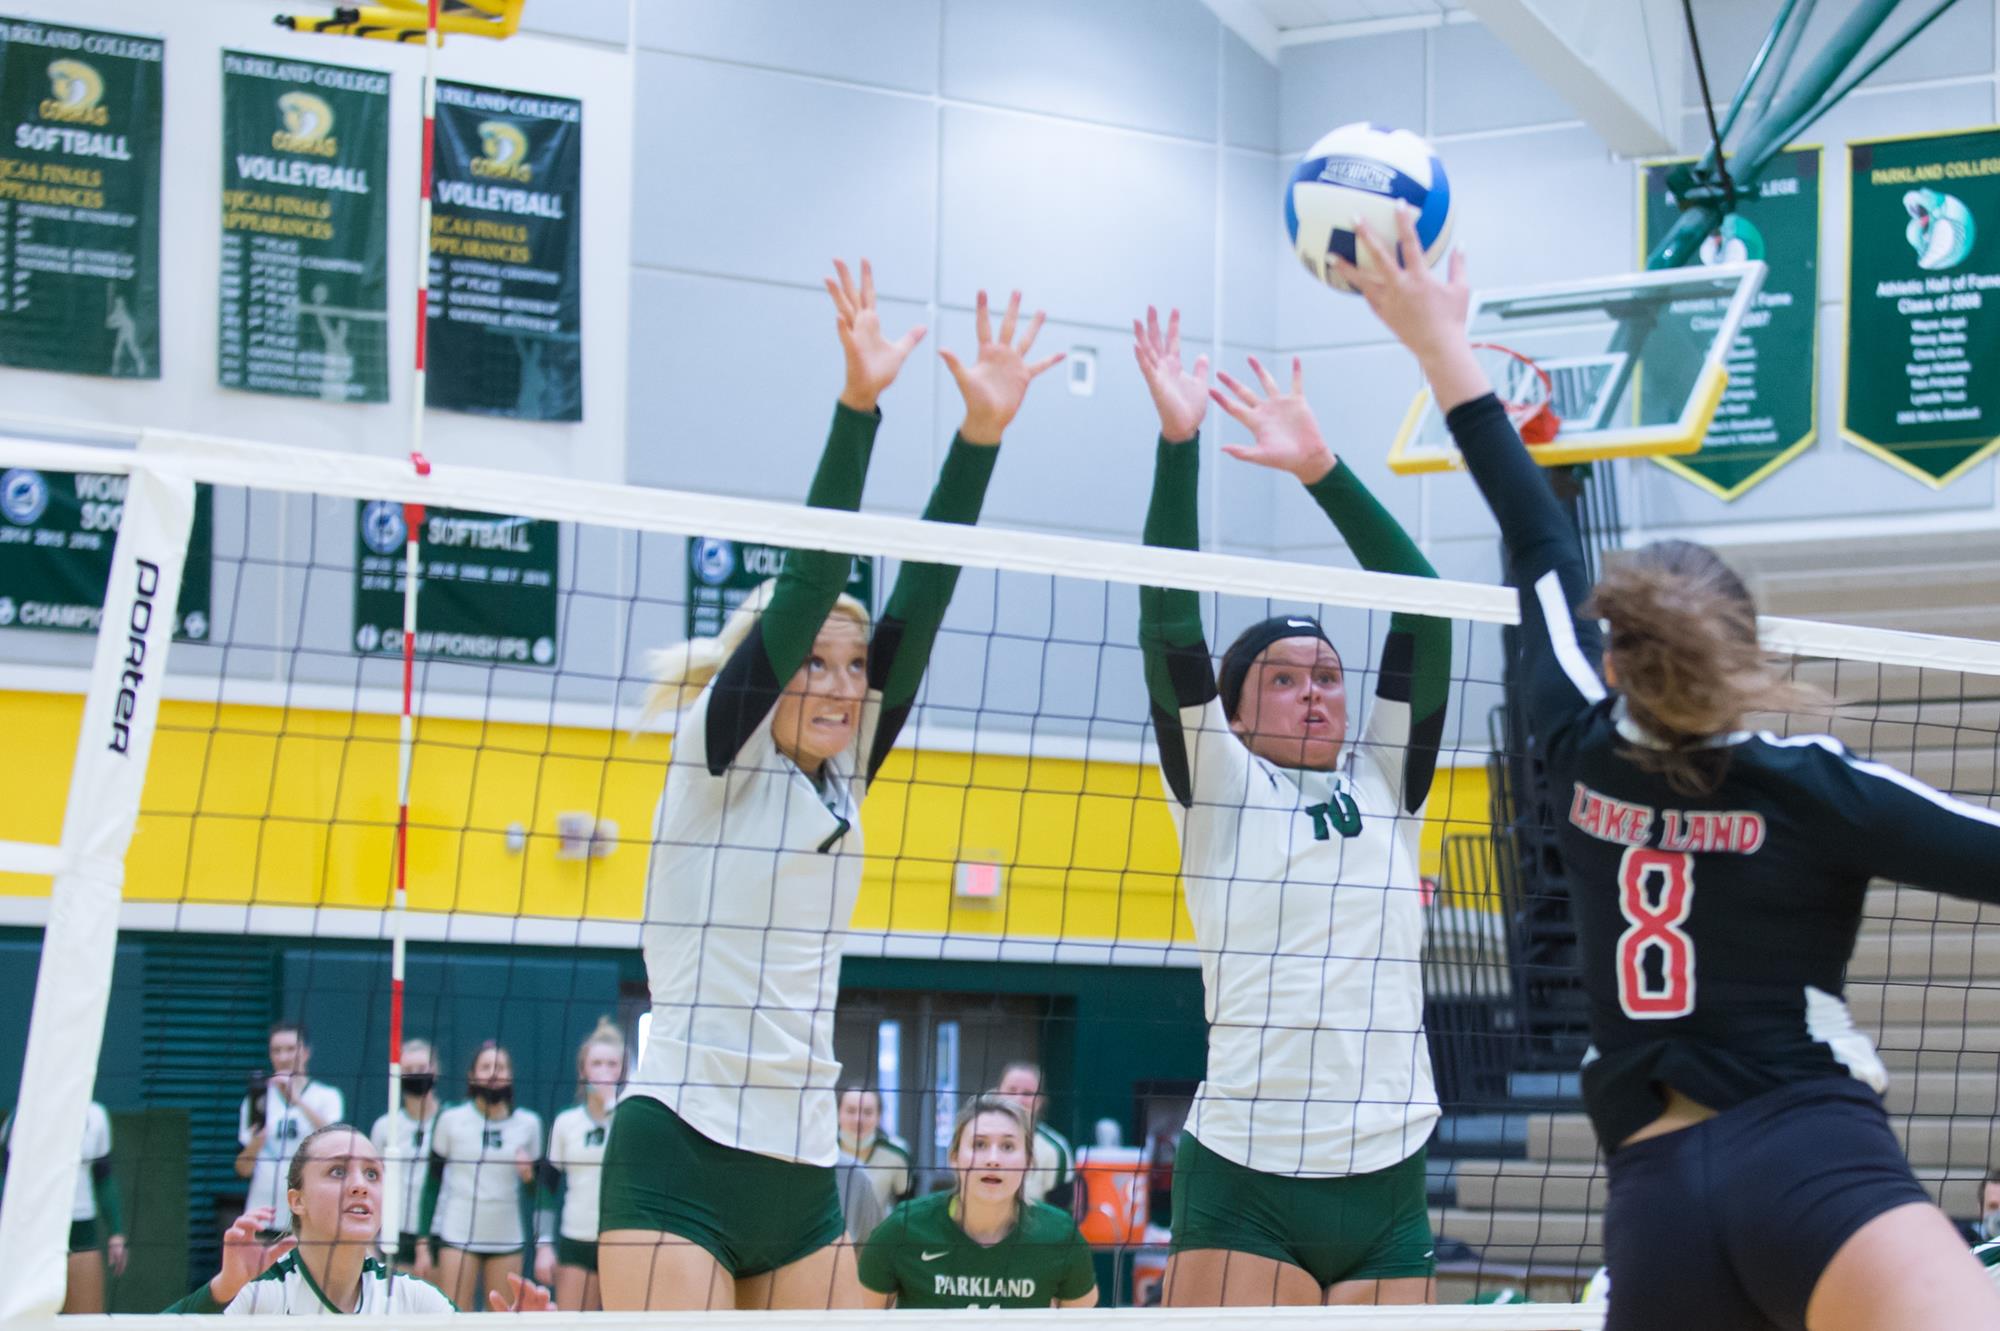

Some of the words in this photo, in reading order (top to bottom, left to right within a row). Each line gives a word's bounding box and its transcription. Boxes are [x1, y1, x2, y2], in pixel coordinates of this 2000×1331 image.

[225, 57, 312, 83] PARKLAND
[313, 69, 389, 96] COLLEGE
[508, 96, 581, 123] COLLEGE
[15, 123, 133, 161] SOFTBALL
[236, 155, 369, 193] VOLLEYBALL
[1871, 163, 1944, 186] PARKLAND
[437, 180, 564, 219] VOLLEYBALL
[1925, 275, 1951, 293] Hall
[1952, 273, 1967, 291] of
[1897, 297, 1934, 315] Class
[1934, 294, 1950, 312] of
[427, 516, 533, 553] SOFTBALL
[381, 627, 530, 661] CHMPIONSHIPS
[1569, 781, 1654, 847] LAKE
[1658, 808, 1766, 855] LAND
[1617, 847, 1695, 1019] 8
[933, 1274, 1036, 1299] PARKLAND
